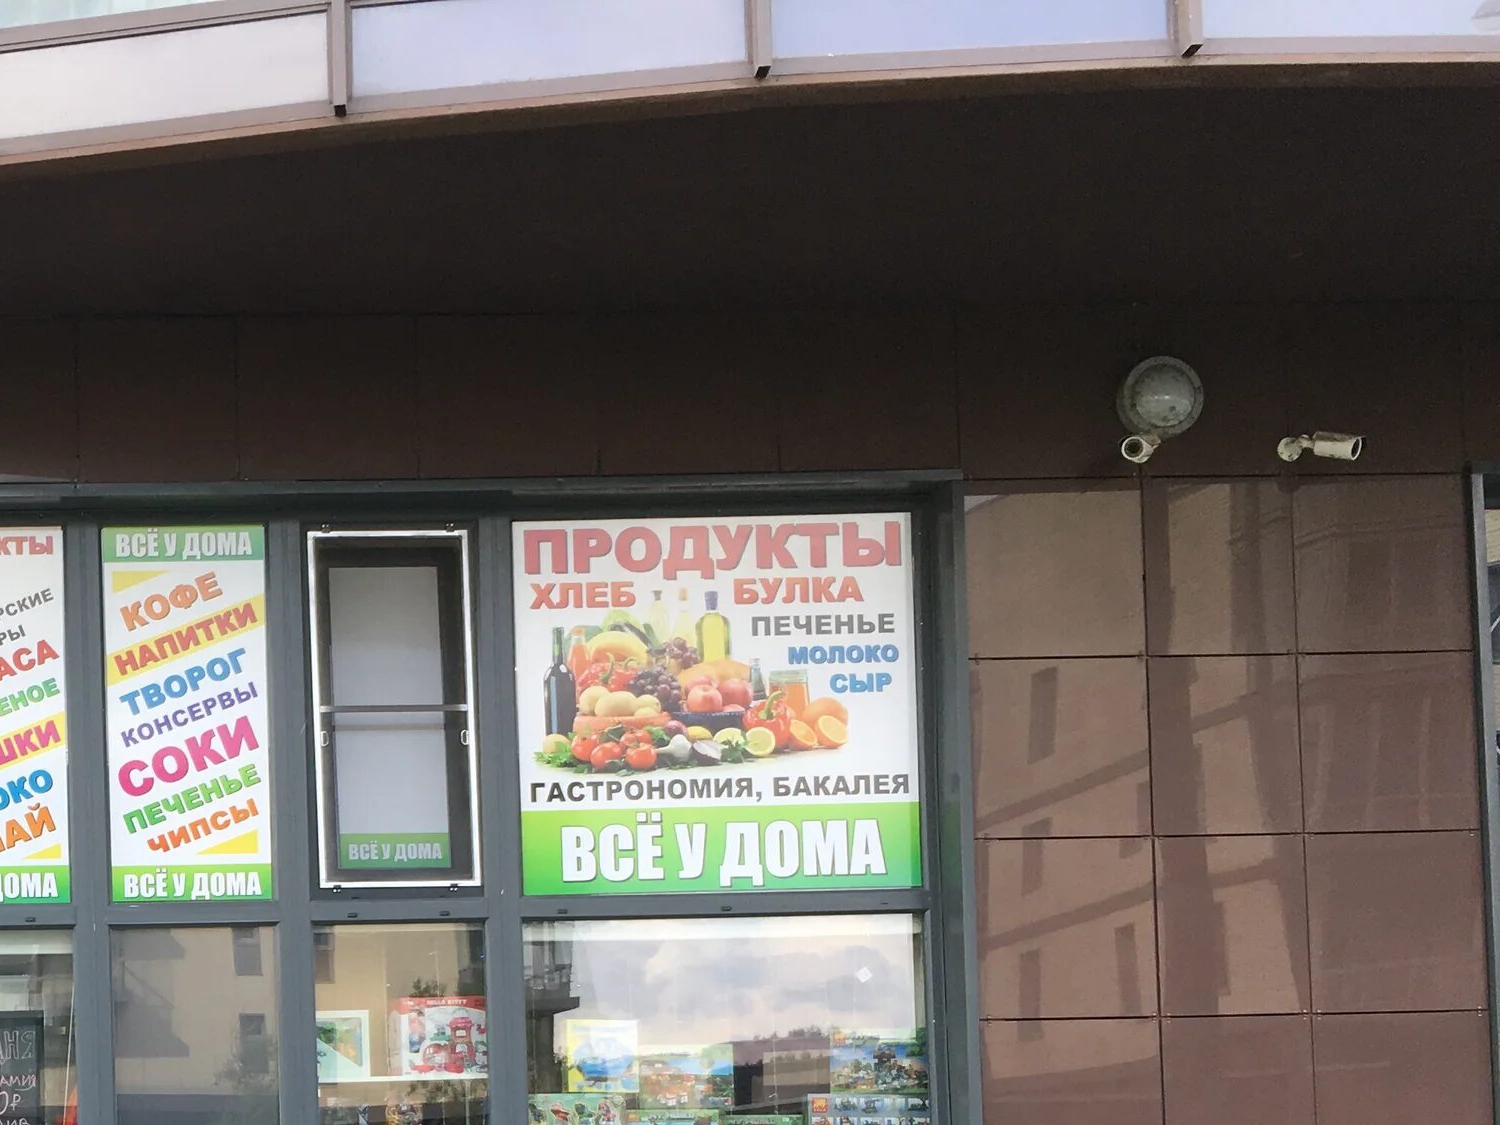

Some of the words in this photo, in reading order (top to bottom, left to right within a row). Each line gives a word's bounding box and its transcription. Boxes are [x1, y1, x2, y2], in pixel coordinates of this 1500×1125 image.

[115, 527, 160, 558] ВСЁ
[165, 534, 179, 557] У
[182, 532, 252, 561] ДОМА
[523, 521, 902, 580] ПРОДУКТЫ
[119, 571, 224, 632] КОФЕ
[530, 581, 637, 610] ХЛЕБ
[733, 576, 864, 605] БУЛКА
[113, 601, 258, 676] НАПИТКИ
[751, 613, 896, 637] ПЕЧЕНЬЕ
[119, 647, 247, 716] ТВОРОГ
[787, 644, 900, 665] МОЛОКО
[829, 671, 893, 694] СЫР
[119, 681, 259, 748] КОНСЕРВЫ
[117, 715, 260, 797] СОКИ
[122, 763, 262, 835] ПЕЧЕНЬЕ
[530, 776, 763, 803] ГАСТРОНОМИЯ,
[773, 773, 911, 797] БАКАЛЕЯ
[146, 798, 260, 854] ЧИПСЫ
[348, 840, 379, 861] ВСЁ
[381, 843, 391, 860] У
[394, 842, 443, 862] ДОМА
[560, 811, 666, 883] ВСЁ
[674, 822, 708, 880] У
[719, 818, 888, 888] ДОМА
[123, 868, 168, 898] ВСЁ
[173, 874, 187, 898] У
[191, 871, 263, 901] ДОМА
